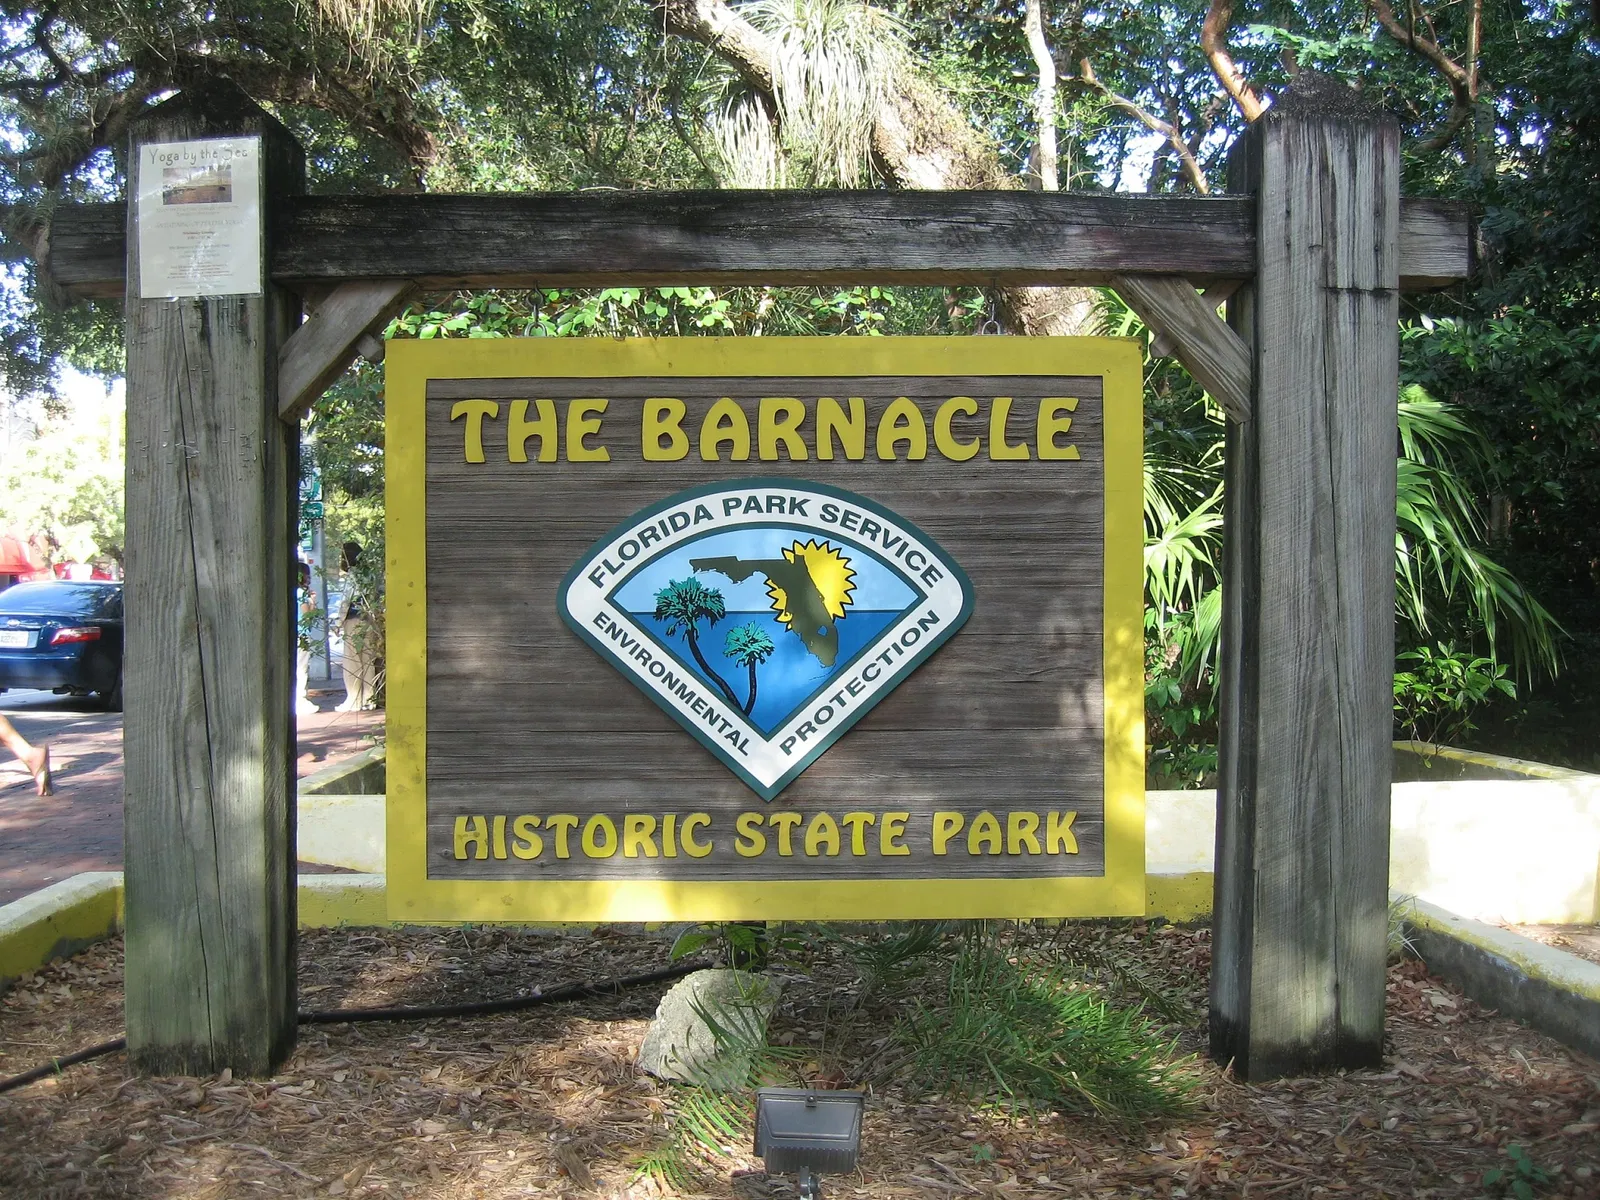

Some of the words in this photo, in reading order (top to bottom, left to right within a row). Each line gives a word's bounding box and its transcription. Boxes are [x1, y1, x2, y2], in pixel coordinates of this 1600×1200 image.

[149, 149, 179, 166] Yoga
[183, 147, 197, 165] by
[200, 147, 218, 159] the
[450, 399, 609, 463] THE
[642, 397, 1081, 462] BARNACLE
[588, 504, 714, 589] FLORIDA
[721, 494, 811, 517] PARK
[819, 504, 944, 589] SERVICE
[593, 611, 750, 757] ENVIRONMENTAL
[779, 609, 941, 756] PROTECTION
[453, 814, 713, 860] HISTORIC
[734, 811, 911, 858] STATE
[932, 810, 1079, 855] PARK
